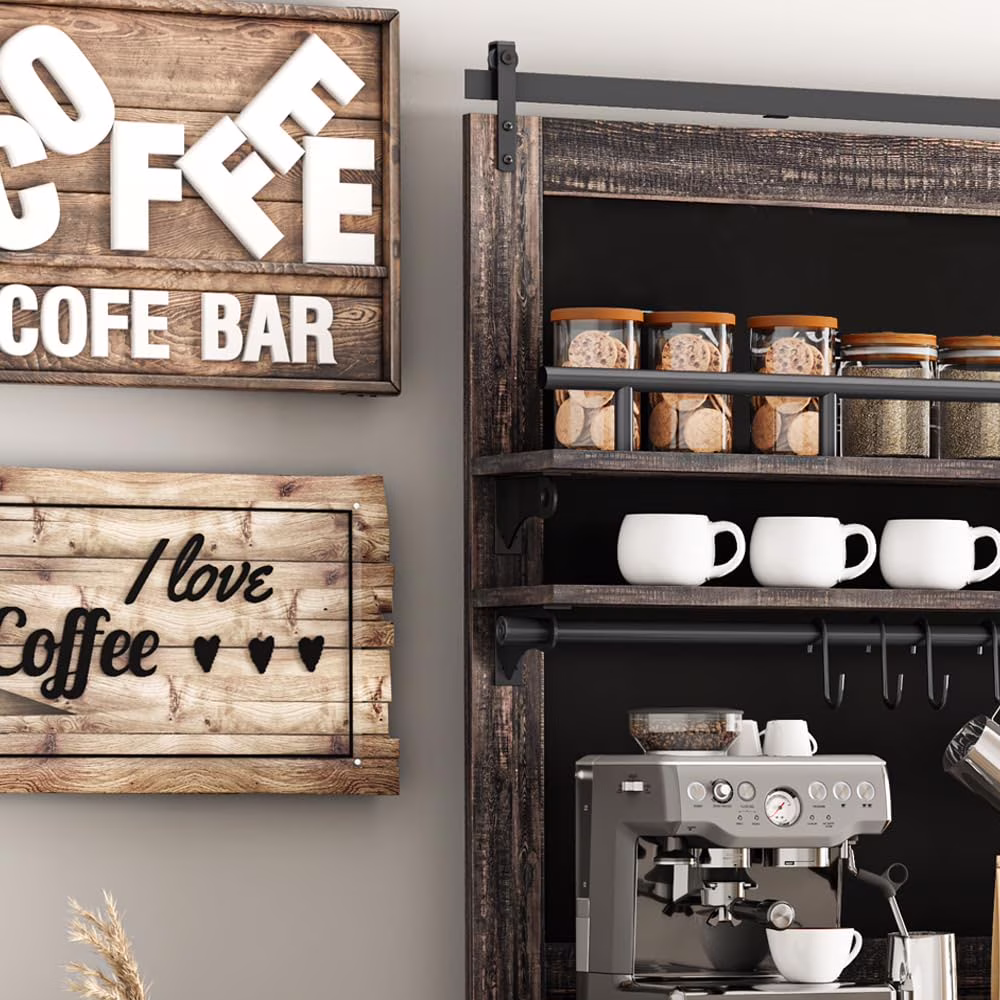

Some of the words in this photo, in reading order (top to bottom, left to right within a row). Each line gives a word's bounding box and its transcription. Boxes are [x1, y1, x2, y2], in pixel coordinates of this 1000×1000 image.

[0, 284, 170, 359] COFE
[201, 293, 337, 365] BAR
[167, 533, 274, 604] love
